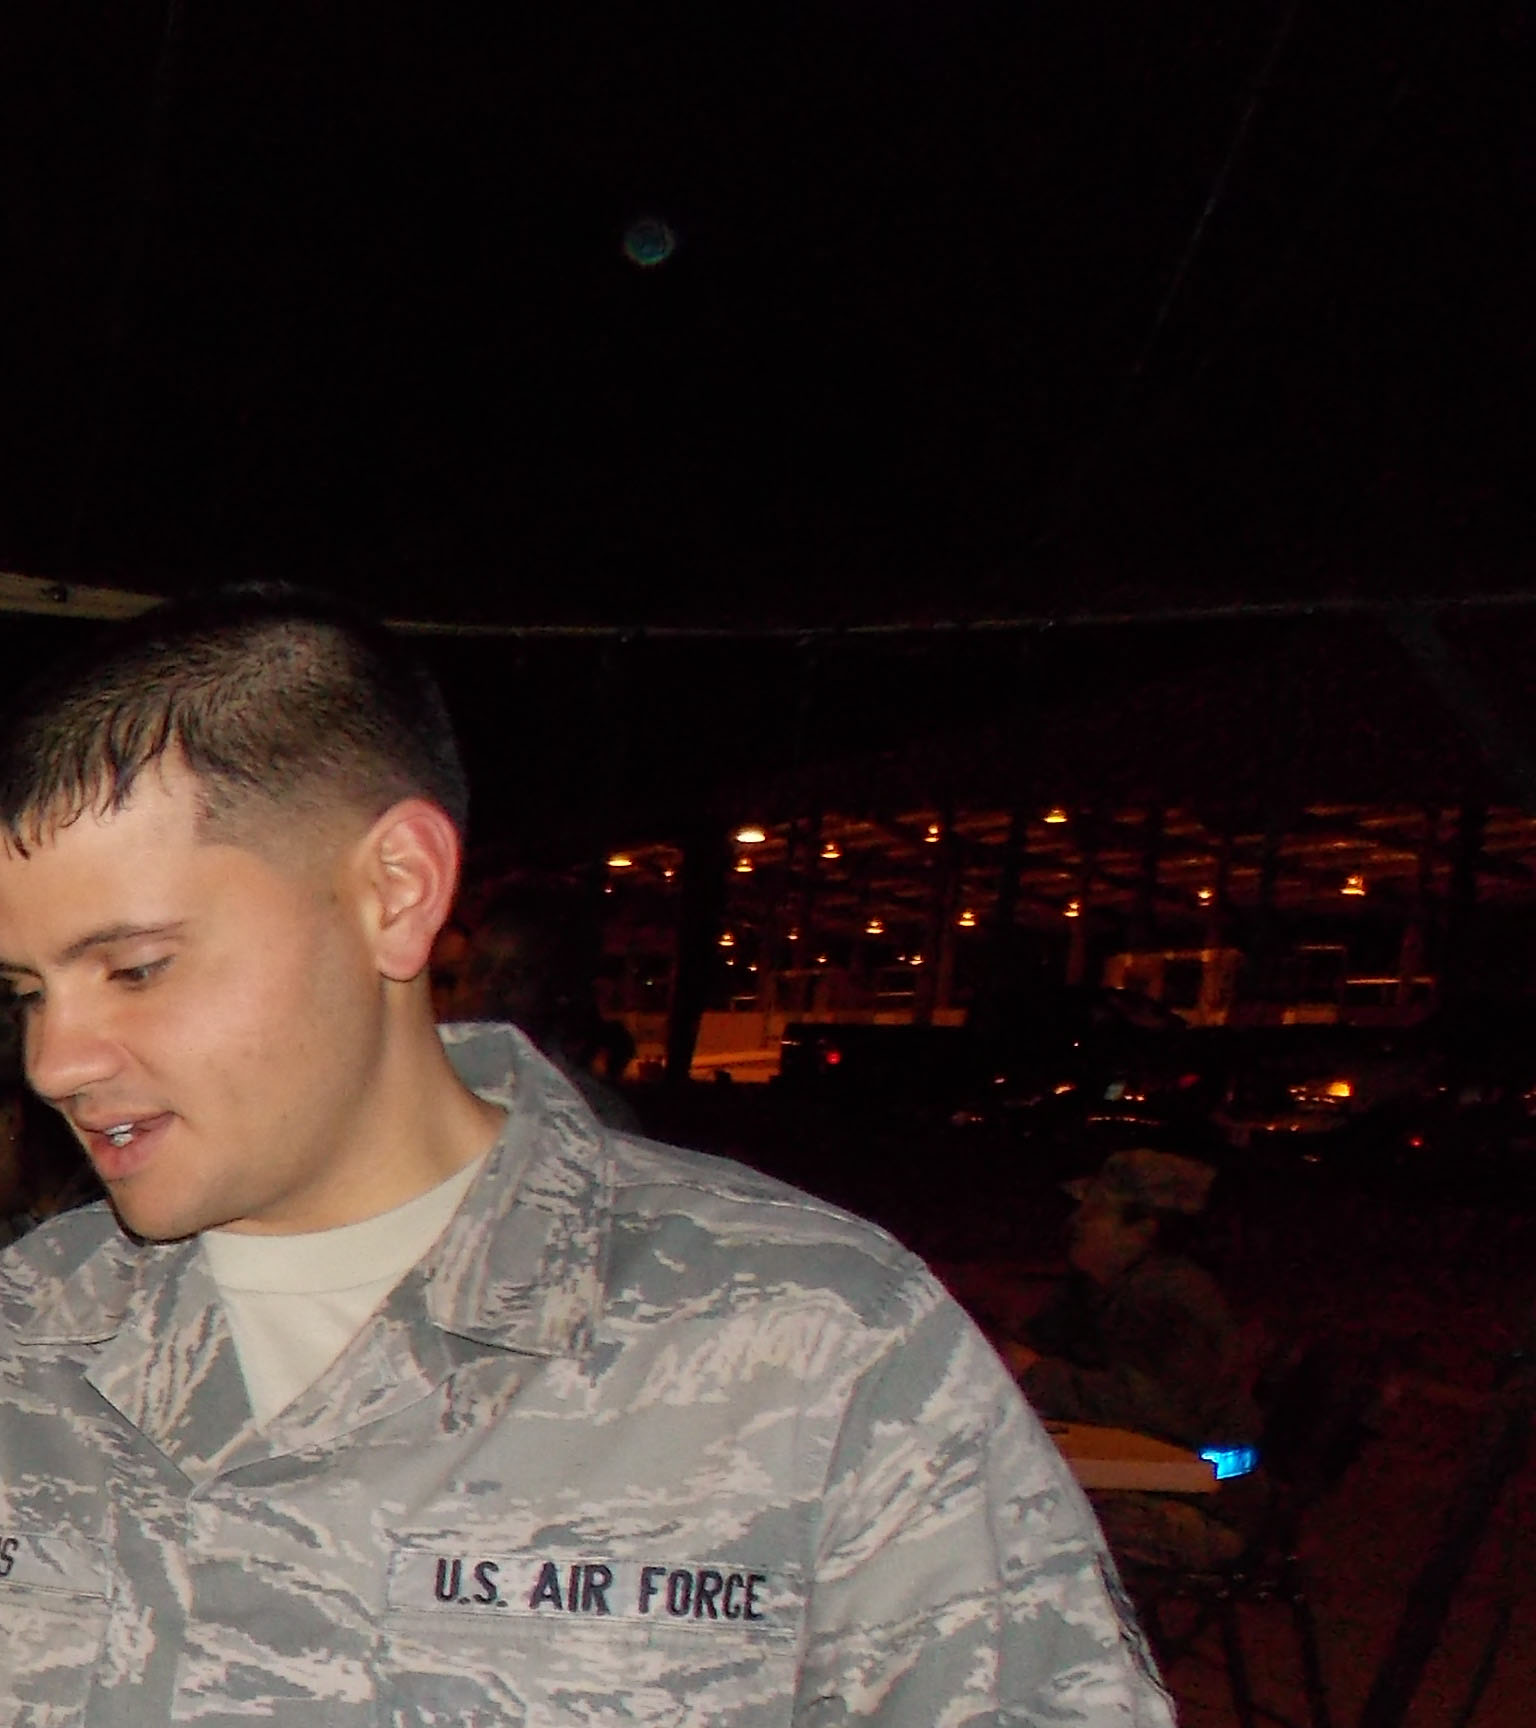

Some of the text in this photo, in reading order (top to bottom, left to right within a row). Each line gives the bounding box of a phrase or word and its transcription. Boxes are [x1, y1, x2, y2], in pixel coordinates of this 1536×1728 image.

[434, 1557, 767, 1622] U.S. AIR FORCE
